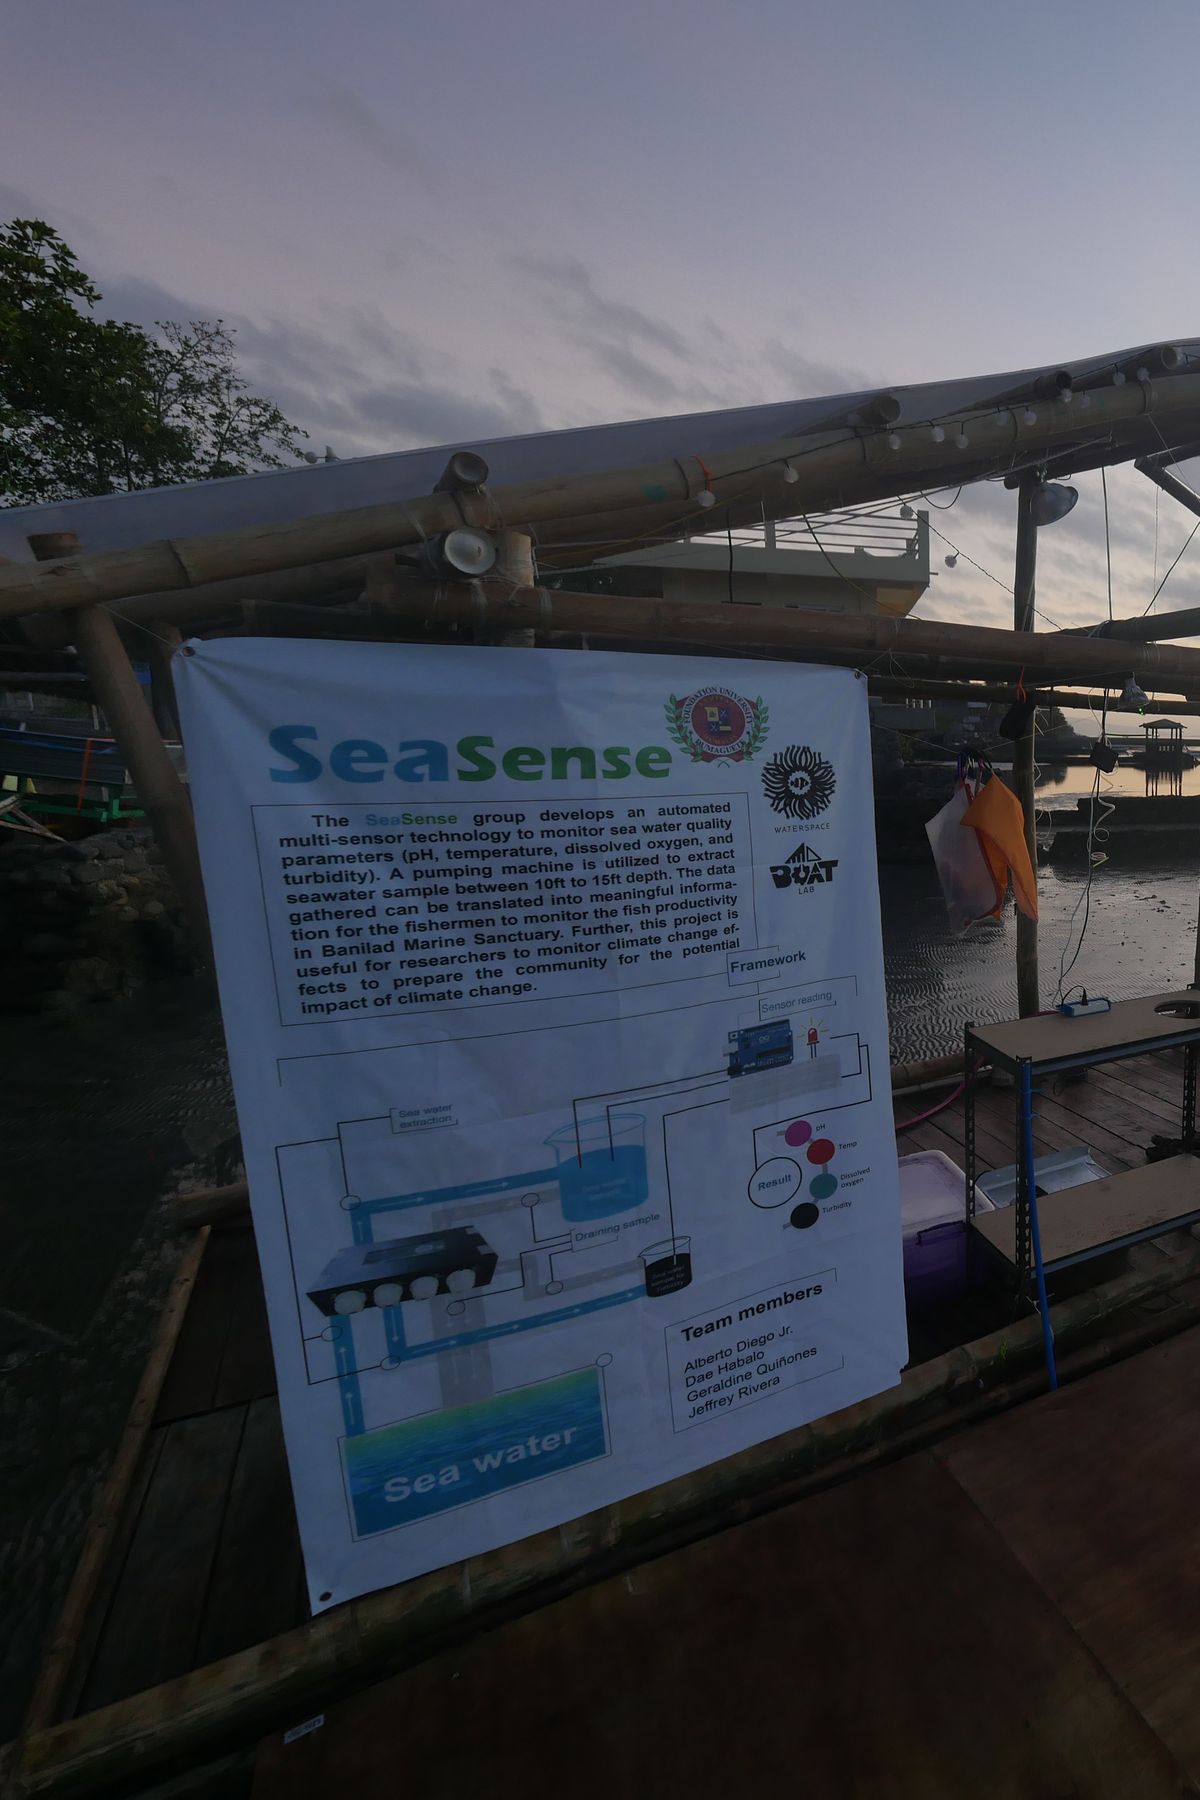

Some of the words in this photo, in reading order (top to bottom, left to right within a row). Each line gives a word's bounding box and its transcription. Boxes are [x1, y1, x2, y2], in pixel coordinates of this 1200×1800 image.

[684, 687, 717, 724] FOUNDATION
[720, 687, 753, 724] UNIVERSITY
[268, 724, 673, 784] SeaSense
[311, 814, 350, 828] The
[366, 811, 458, 826] SeaSense
[472, 812, 526, 828] group
[539, 808, 615, 824] develops
[626, 808, 646, 819] an
[657, 801, 731, 817] automated
[774, 822, 831, 834] WATERSPACE
[279, 833, 405, 848] multi-sensor
[409, 828, 512, 844] technology
[516, 828, 535, 840] to
[539, 825, 606, 839] monitor
[609, 825, 638, 836] sea
[641, 821, 683, 834] water
[686, 817, 733, 833] quality
[281, 851, 395, 870] parameters
[401, 848, 439, 865] (pH,
[445, 845, 558, 862] temperature,
[564, 838, 642, 855] dissolved
[646, 837, 704, 852] oxygen,
[707, 832, 734, 846] and
[282, 868, 381, 886] turbidity).
[389, 867, 405, 881] A
[412, 864, 493, 882] pumping
[501, 860, 575, 875] machine
[581, 858, 597, 871] is
[604, 853, 660, 870] utilized
[665, 853, 681, 865] to
[687, 848, 736, 863] extract
[286, 888, 377, 905] seawater
[381, 883, 450, 900] sample
[454, 881, 529, 895] between
[534, 876, 567, 891] 10ft
[569, 876, 588, 888] to
[591, 873, 623, 887] 15ft
[625, 868, 673, 885] depth.
[675, 866, 703, 879] The
[706, 863, 736, 877] data
[798, 886, 815, 895] LAB
[288, 904, 377, 926] gathered
[384, 905, 420, 917] can
[426, 901, 449, 914] be
[455, 894, 544, 912] translated
[550, 893, 584, 906] into
[589, 884, 675, 904] meaningful
[679, 880, 738, 895] informa-
[289, 928, 330, 942] tion
[335, 924, 364, 938] for
[367, 922, 400, 936] the
[404, 917, 496, 934] fishermen
[500, 915, 519, 927] to
[523, 909, 590, 925] monitor
[592, 907, 619, 920] the
[621, 903, 652, 917] fish
[655, 893, 738, 916] productivity
[293, 947, 313, 960] in
[321, 939, 396, 958] Banilad
[403, 935, 467, 952] Marine
[473, 929, 565, 946] Sanctuary.
[571, 922, 634, 937] Further,
[639, 916, 668, 931] this
[673, 910, 723, 930] project
[727, 908, 739, 920] is
[296, 960, 358, 979] useful
[363, 959, 392, 973] for
[399, 951, 507, 970] researchers
[512, 947, 531, 960] to
[536, 941, 602, 957] monitor
[607, 934, 663, 951] climate
[666, 928, 719, 943] change
[722, 922, 740, 936] ef-
[297, 981, 348, 996] fects
[359, 978, 380, 991] to
[392, 971, 464, 991] prepare
[474, 967, 504, 980] the
[515, 956, 608, 976] community
[617, 953, 641, 966] for
[648, 948, 673, 961] the
[682, 937, 741, 959] potential
[730, 950, 806, 973] Framework
[300, 996, 369, 1016] impact
[372, 993, 393, 1007] of
[397, 988, 464, 1005] climate
[468, 982, 538, 998] change.
[761, 1001, 796, 1013] Sensor
[798, 991, 832, 1005] reading
[398, 1109, 420, 1118] Sea
[399, 1115, 452, 1129] extraction
[816, 1123, 826, 1132] pH
[838, 1141, 858, 1150] Temp
[758, 1174, 792, 1191] Result
[840, 1167, 871, 1180] Dissolved
[841, 1177, 864, 1188] oxygen
[822, 1201, 852, 1213] Turbidity
[575, 1224, 621, 1241] Draining
[622, 1214, 661, 1230] sample
[682, 1315, 733, 1342] Team
[738, 1284, 824, 1321] members
[683, 1347, 733, 1374] Alberto
[736, 1331, 775, 1353] Diego
[778, 1325, 793, 1340] Jr.
[685, 1370, 714, 1388] Dae
[718, 1350, 766, 1375] Habalo
[687, 1370, 753, 1402] Geraldine
[756, 1346, 818, 1376] Quiñones
[688, 1393, 735, 1419] Jeffrey
[738, 1376, 780, 1399] Rivera
[383, 1465, 461, 1503] Sea
[472, 1426, 577, 1473] water
